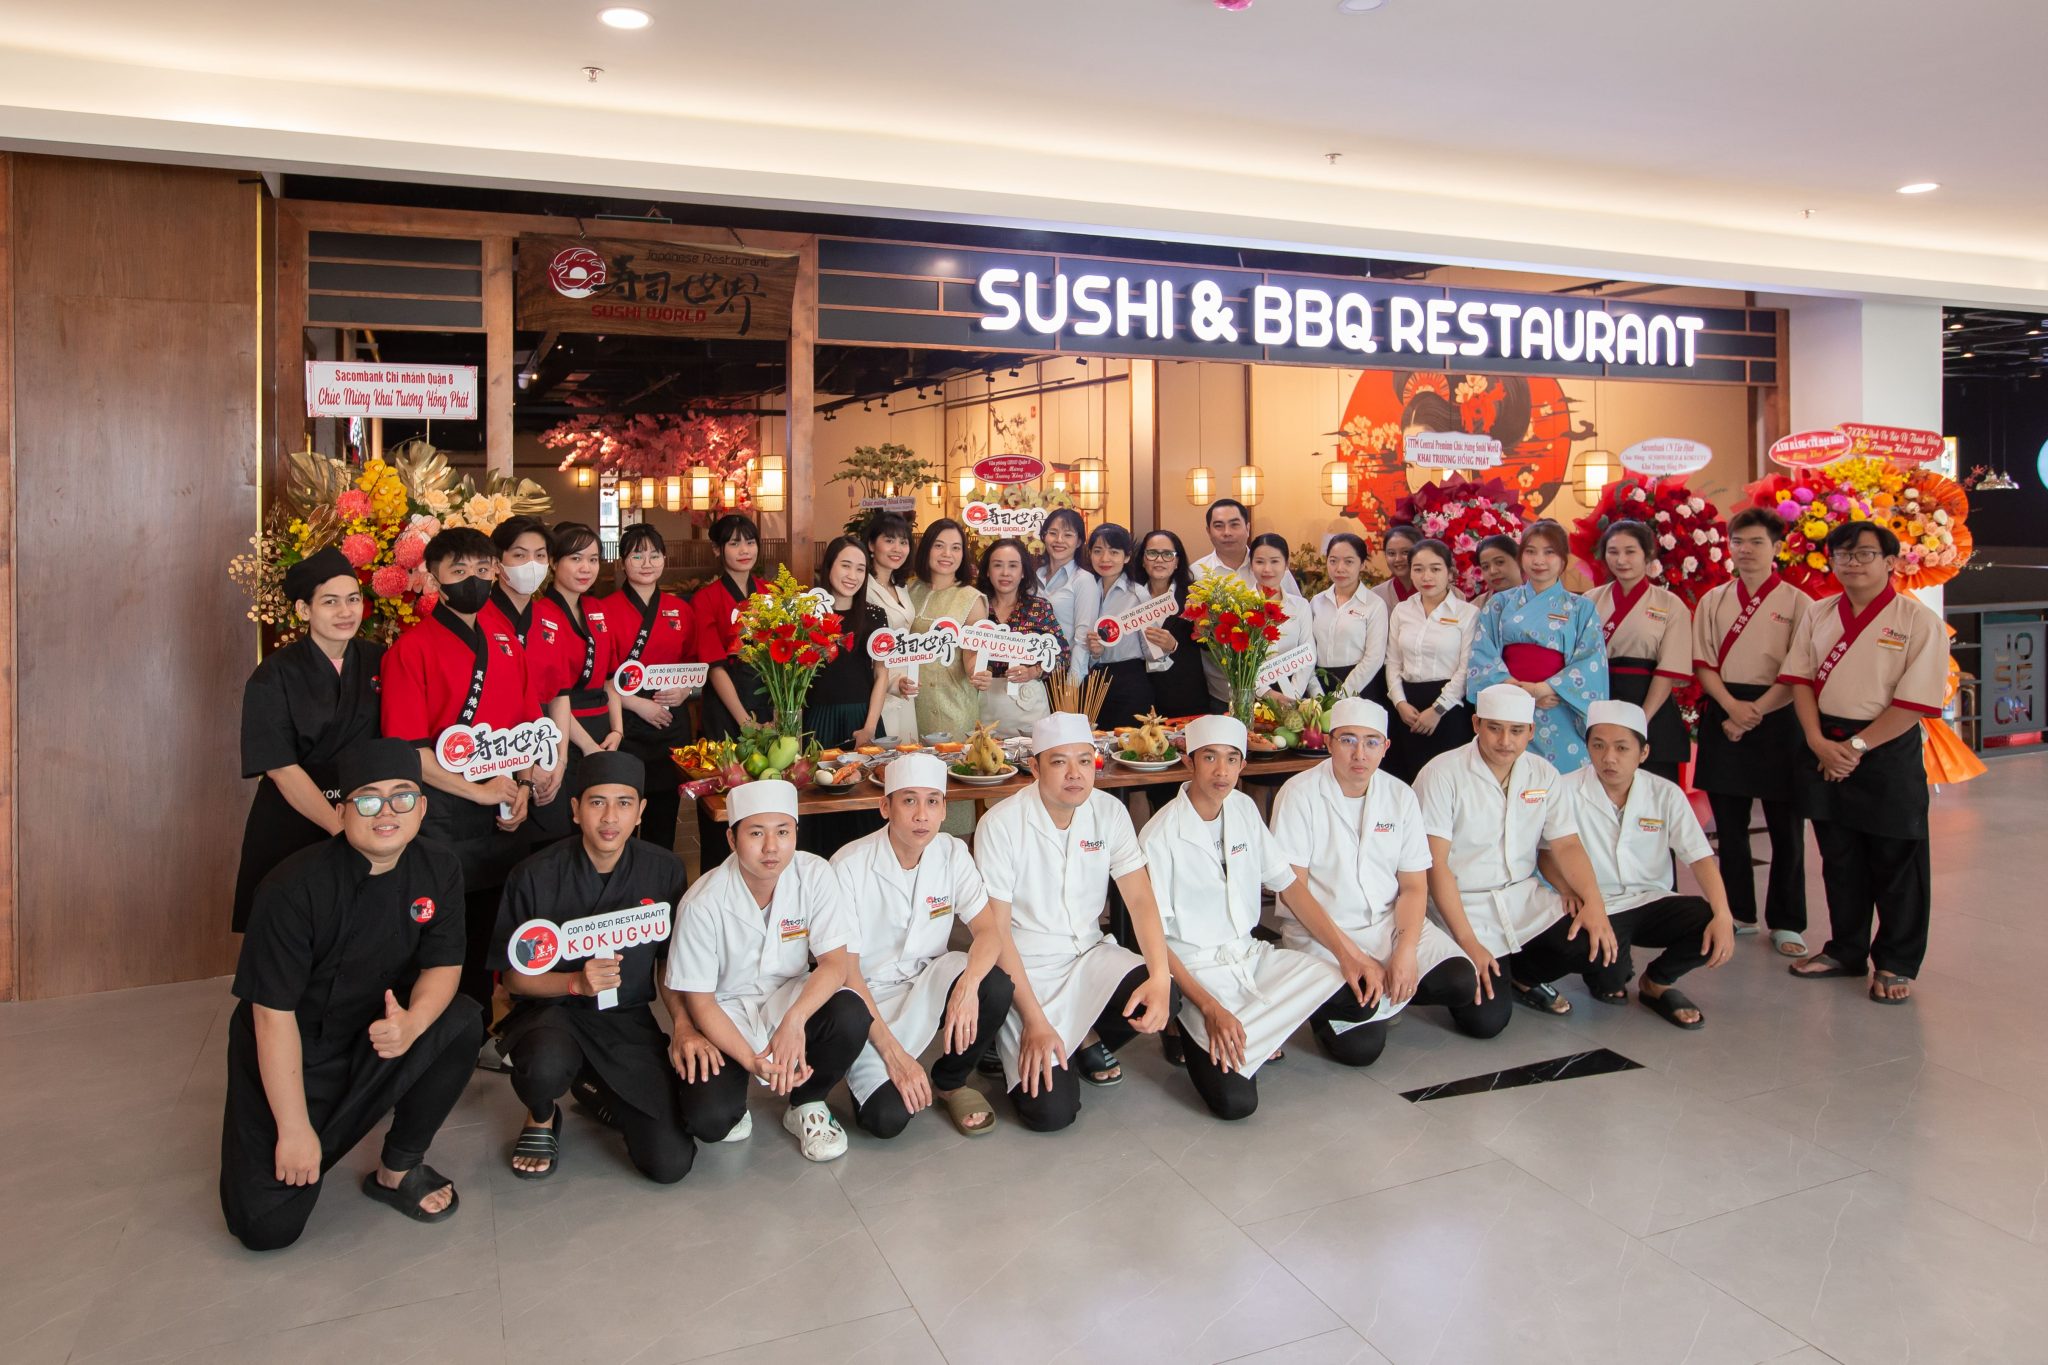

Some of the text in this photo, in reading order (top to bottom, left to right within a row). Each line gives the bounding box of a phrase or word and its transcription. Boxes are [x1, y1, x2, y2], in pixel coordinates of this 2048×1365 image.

[647, 249, 769, 268] Japanese Restaurant
[592, 304, 706, 322] SUSHI WORLD
[979, 269, 1704, 368] SUSHI & BBQ RESTAURANT
[335, 369, 454, 387] Sacombank Chi nhánh Quận 8
[318, 387, 341, 406] Chúc
[373, 389, 394, 407] Khai
[450, 390, 469, 408] Phát
[1420, 439, 1434, 449] Central
[1435, 440, 1453, 450] Premium
[1487, 442, 1499, 453] World
[1417, 453, 1431, 462] KHAI
[1123, 602, 1176, 631] KOKUGYU
[962, 636, 1025, 655] KOKUGYU
[889, 653, 934, 664] SUSHI WORLD
[1260, 653, 1313, 684] KOKUGYU
[647, 675, 704, 686] KOKUGYU
[467, 724, 557, 766] 寿司世界
[470, 755, 530, 776] SUSHI WORLD
[323, 789, 341, 799] OK
[585, 922, 596, 932] BÒ
[615, 909, 665, 925] RESTAURANT
[568, 921, 666, 954] KOKUGYU
